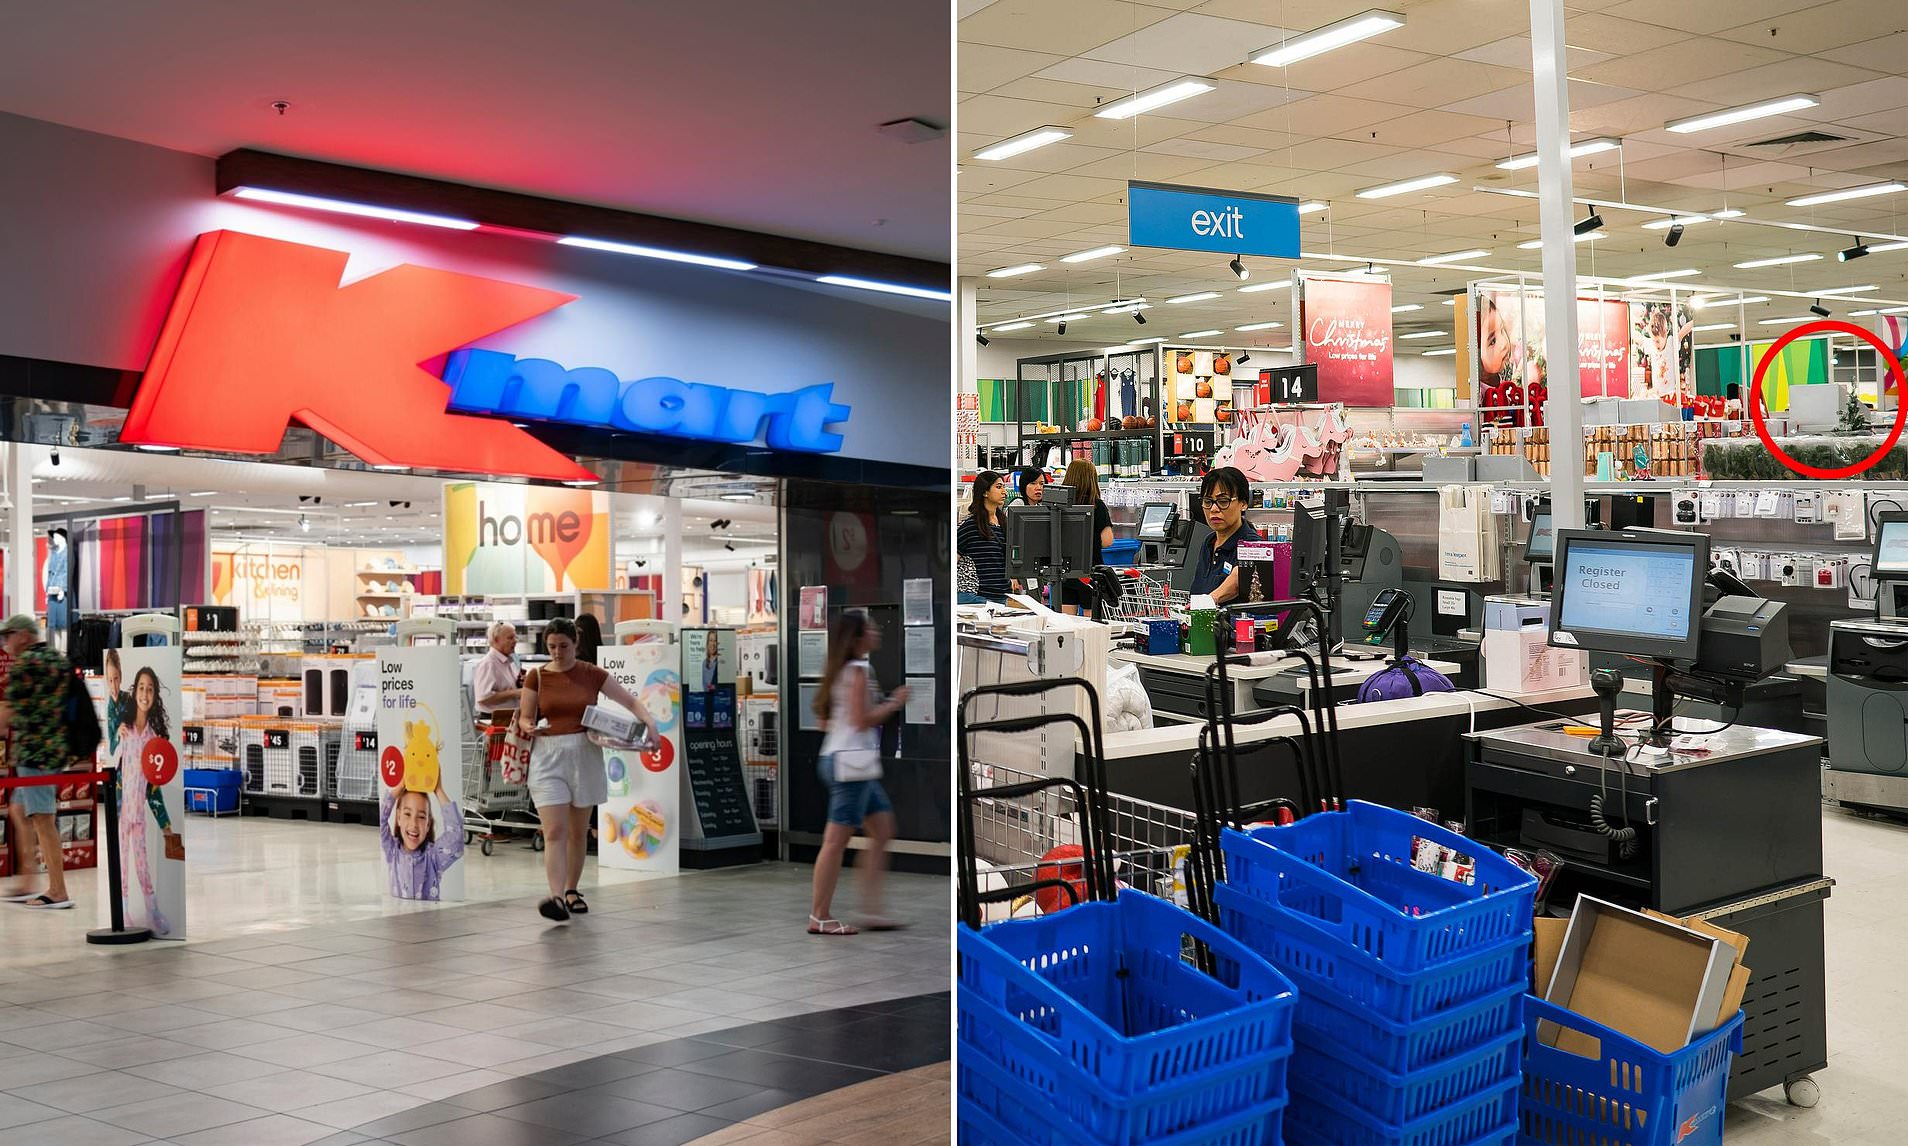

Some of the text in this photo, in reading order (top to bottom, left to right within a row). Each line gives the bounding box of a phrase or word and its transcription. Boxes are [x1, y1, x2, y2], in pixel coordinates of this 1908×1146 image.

[1191, 205, 1244, 239] exit
[1309, 317, 1389, 352] Christmas
[119, 228, 852, 483] Kmart
[1281, 375, 1303, 399] 14
[1185, 437, 1205, 452] $10
[479, 500, 580, 547] home
[231, 557, 300, 580] kitchen
[1579, 565, 1626, 578] Register
[1581, 578, 1620, 590] Closed
[206, 612, 218, 631] $1
[381, 660, 402, 674] Low
[603, 657, 625, 669] Low
[381, 676, 414, 693] prices
[383, 694, 417, 709] for life
[148, 753, 164, 772] $9
[385, 759, 396, 776] $2
